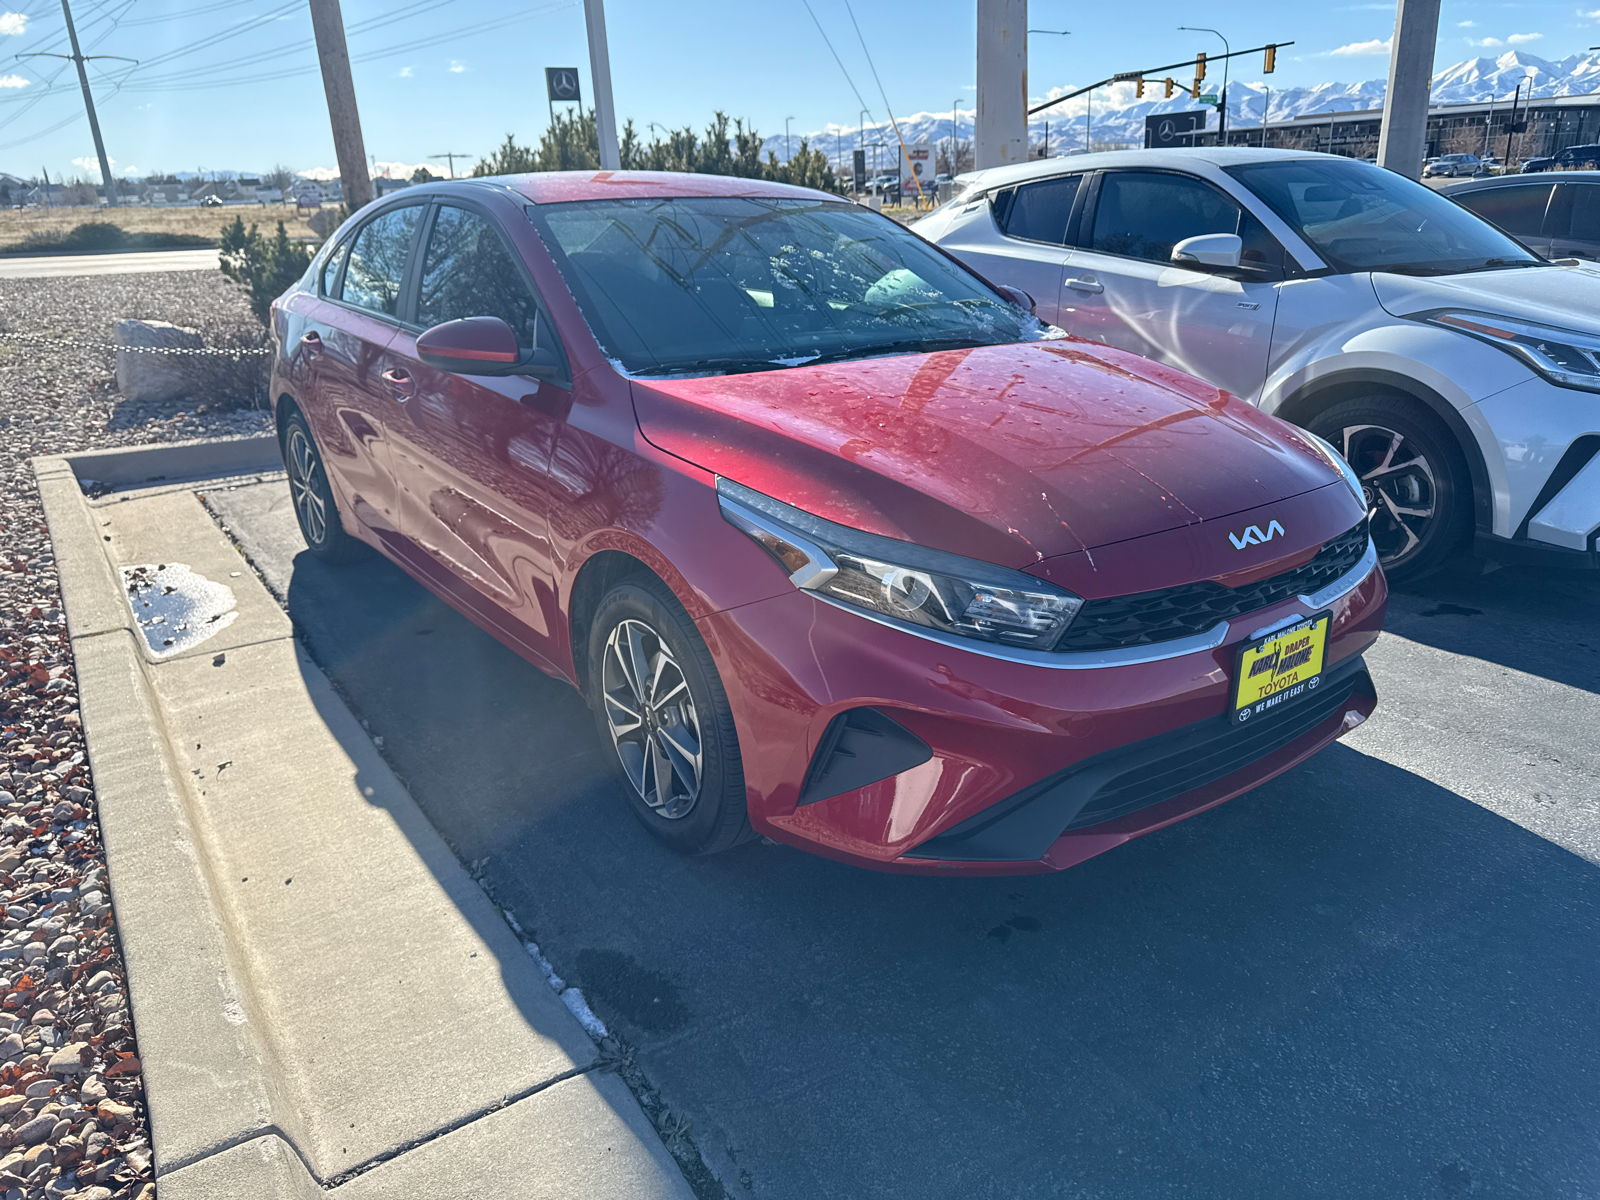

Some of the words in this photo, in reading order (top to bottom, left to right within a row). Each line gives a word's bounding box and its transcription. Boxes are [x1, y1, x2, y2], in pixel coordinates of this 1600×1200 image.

[1228, 519, 1285, 550] KIA
[1264, 635, 1277, 645] KARL
[1277, 626, 1296, 638] MALONE
[1296, 618, 1313, 632] TOYOTA
[1284, 636, 1310, 656] DRAPER
[1247, 651, 1275, 679] KARL
[1275, 644, 1314, 677] MALONE
[1255, 701, 1265, 713] WE
[1265, 694, 1282, 710] MAKE
[1283, 690, 1290, 701] IT
[1290, 683, 1305, 697] EASY
[1258, 671, 1299, 698] TOYOTA
[701, 702, 718, 790] KUMHO
